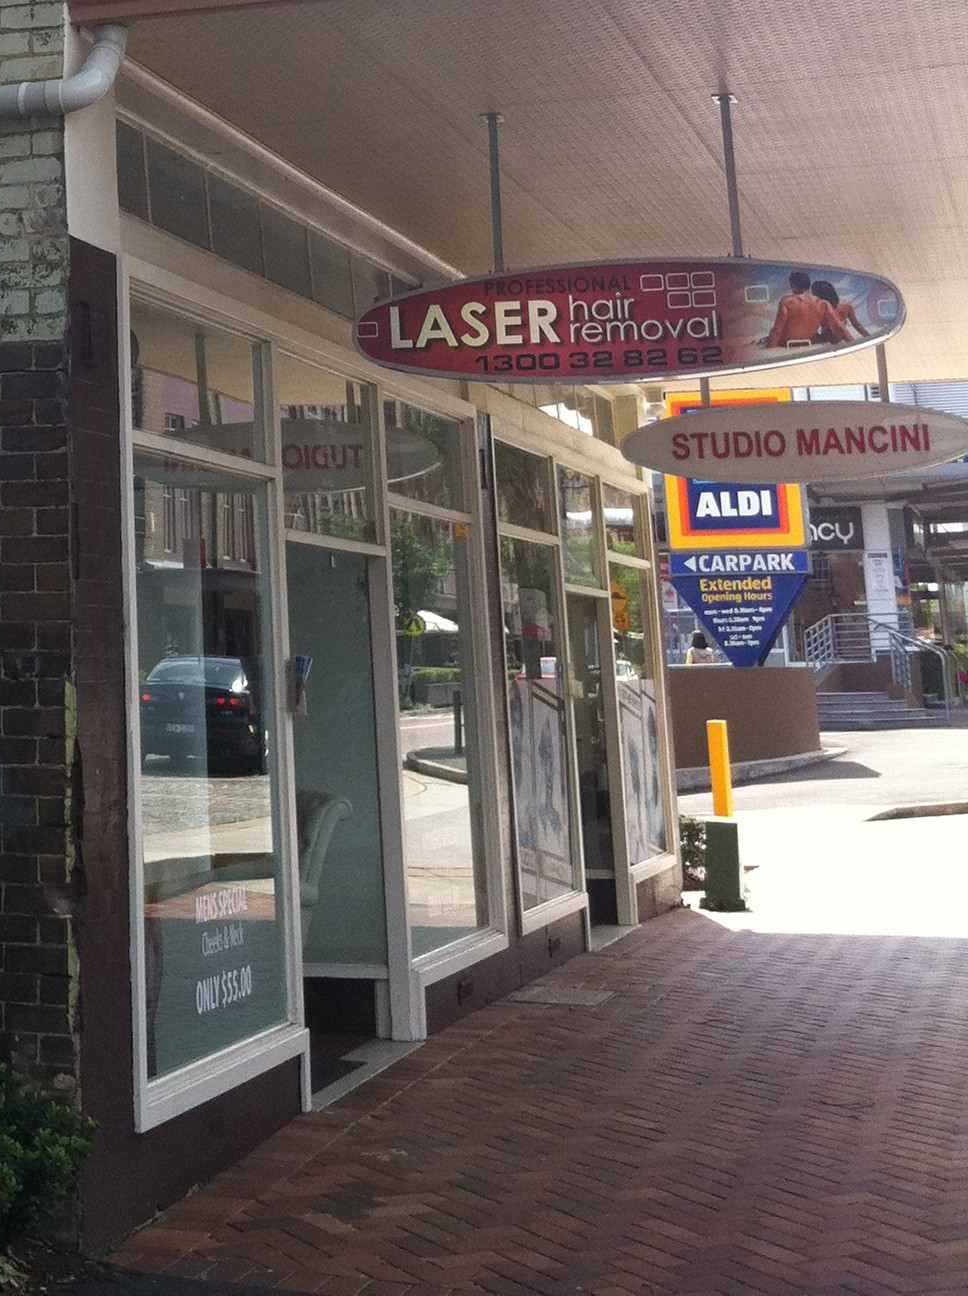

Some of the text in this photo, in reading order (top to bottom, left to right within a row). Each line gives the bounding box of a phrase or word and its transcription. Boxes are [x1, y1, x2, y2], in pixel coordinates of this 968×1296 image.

[483, 273, 631, 296] PROFESSIONAL
[389, 292, 636, 350] LASER hair
[569, 310, 720, 344] removal
[474, 346, 725, 373] 1300 32 82 62
[672, 423, 931, 461] STUDIO MANCINI
[696, 489, 773, 518] ALDI
[698, 552, 795, 572] CARPARK
[699, 576, 773, 592] Extended
[701, 592, 773, 604] Opening Hours
[218, 885, 248, 918] SPECIAL
[196, 964, 252, 1015] ONLY $55.00
